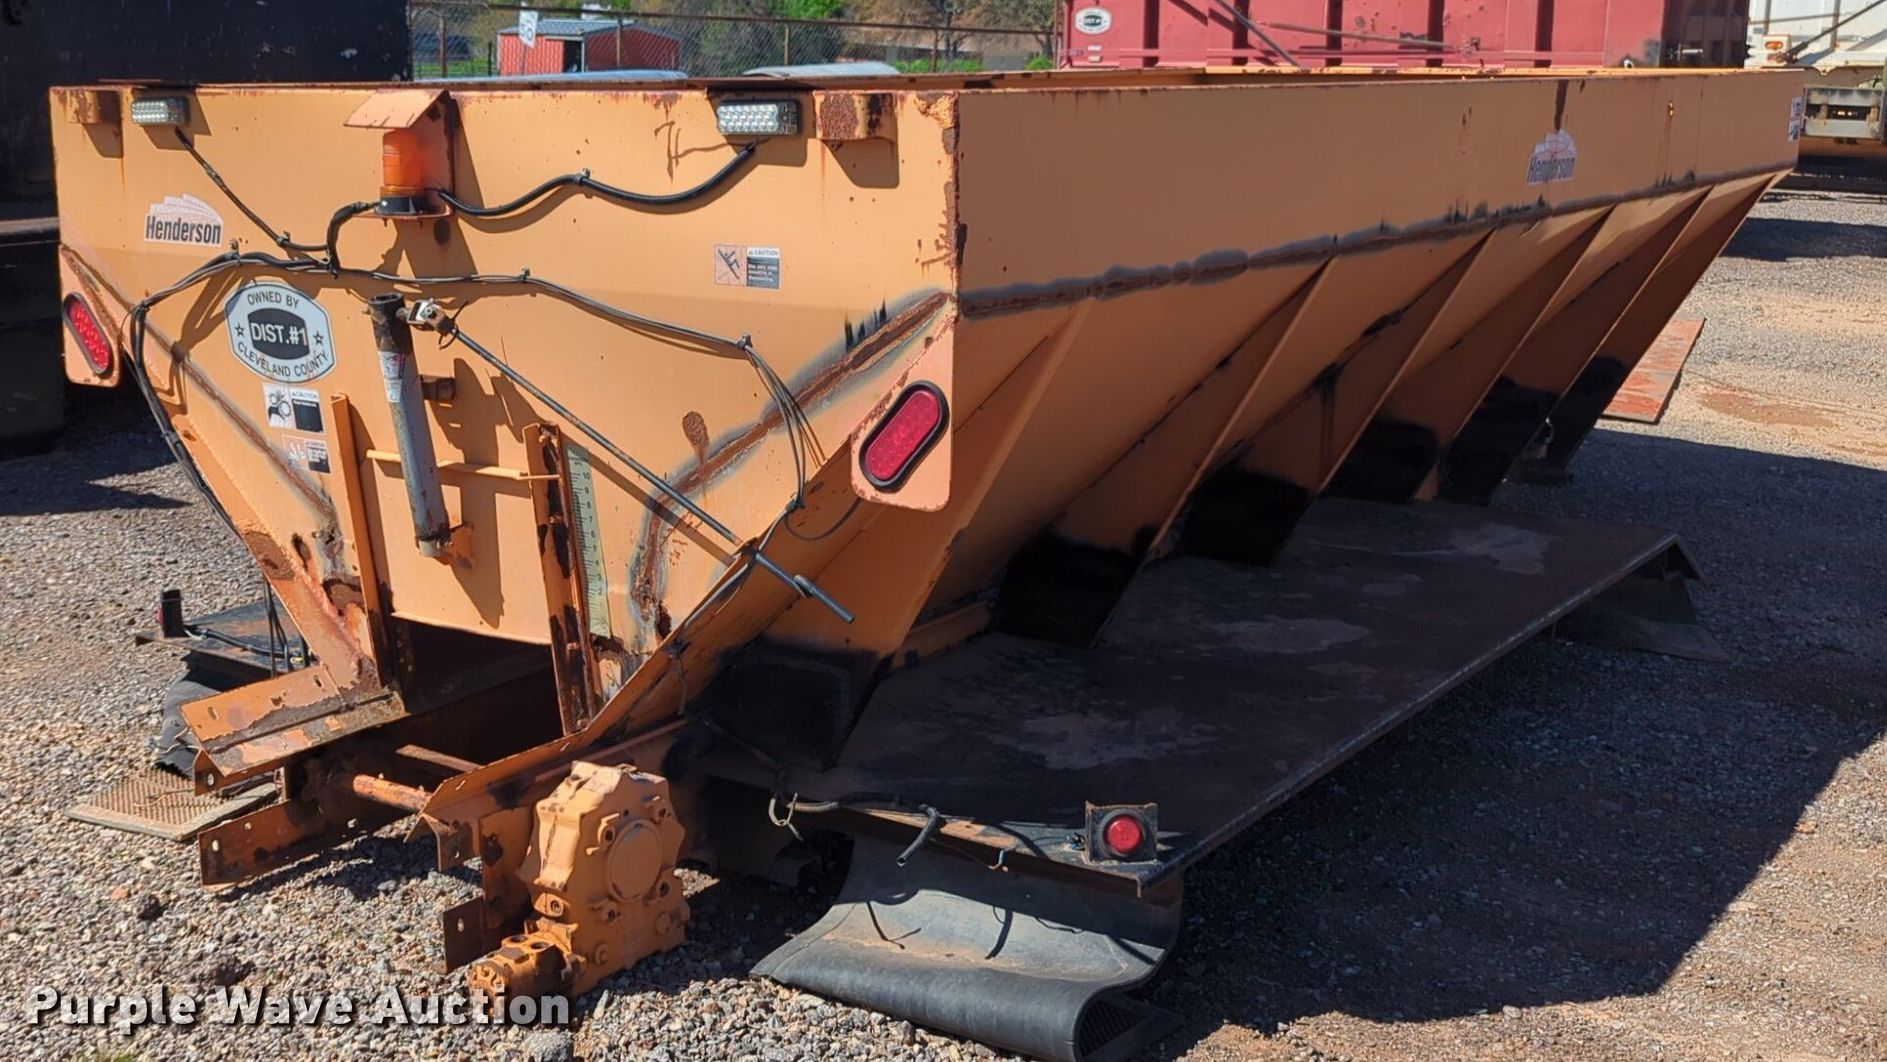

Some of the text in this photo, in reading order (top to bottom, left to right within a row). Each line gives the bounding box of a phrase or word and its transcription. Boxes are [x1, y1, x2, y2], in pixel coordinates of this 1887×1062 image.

[1526, 156, 1575, 183] Henderson
[146, 215, 221, 244] Henderson
[247, 291, 300, 308] OWNED BY
[250, 322, 307, 346] DIST.#1
[238, 341, 329, 377] CLEVELAND COUNTY
[583, 472, 590, 480] 10
